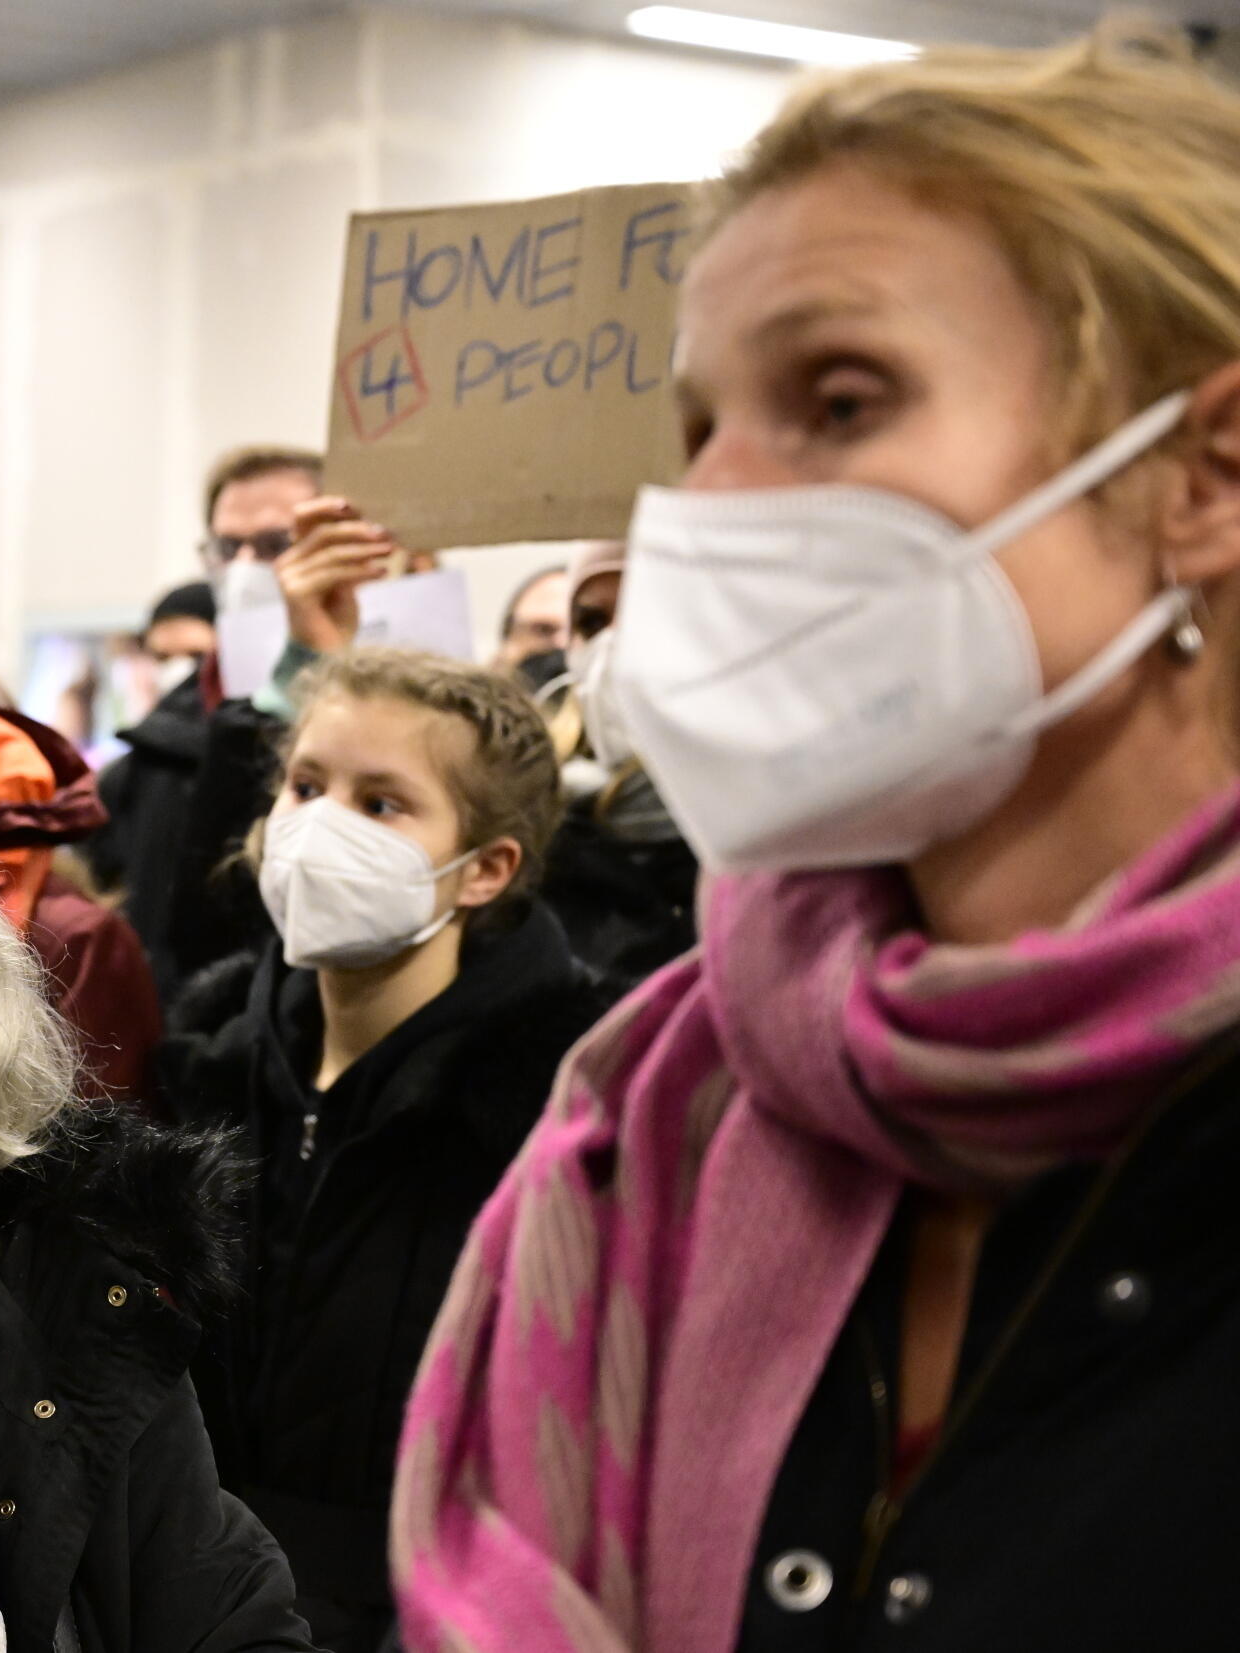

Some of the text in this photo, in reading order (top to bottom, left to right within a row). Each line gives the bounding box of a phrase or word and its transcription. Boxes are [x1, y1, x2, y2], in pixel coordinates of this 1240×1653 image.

[360, 216, 583, 321] HOME
[358, 320, 676, 417] 4 PEOPL
